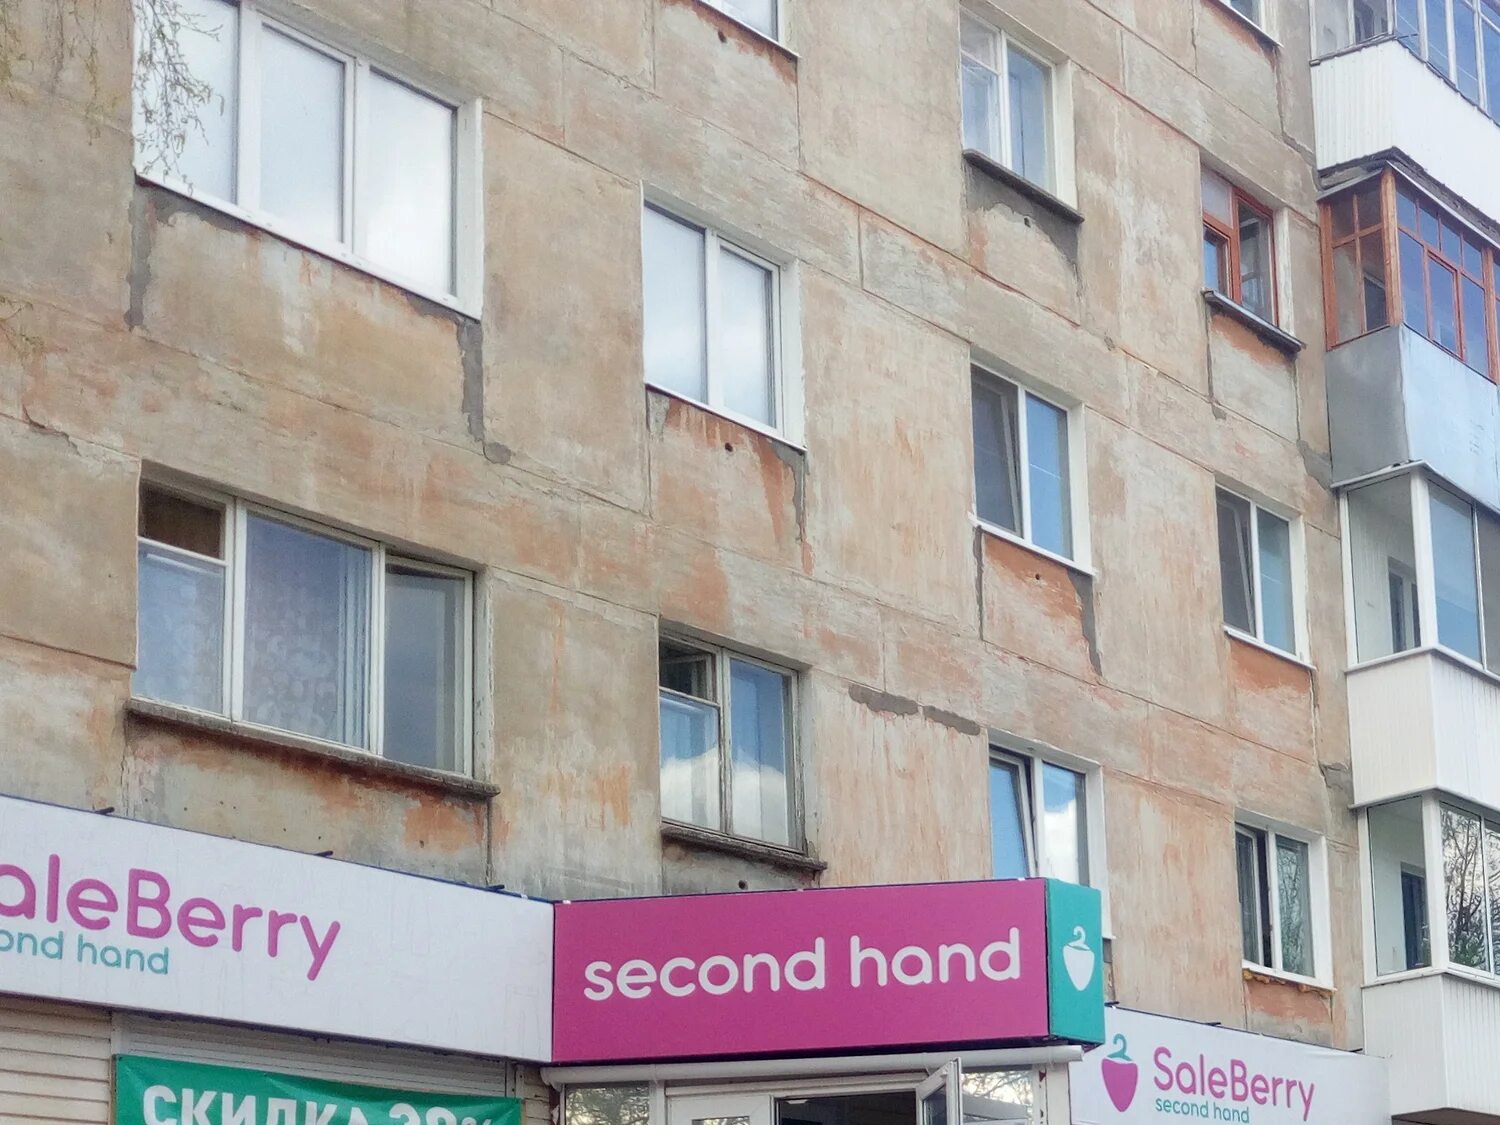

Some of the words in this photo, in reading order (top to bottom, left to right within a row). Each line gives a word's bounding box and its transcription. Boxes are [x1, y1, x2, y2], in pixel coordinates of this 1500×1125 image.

[0, 853, 341, 981] aleBerry
[77, 933, 169, 975] hand
[583, 936, 826, 1001] second
[850, 927, 1022, 988] hand
[1153, 1046, 1315, 1122] SaleBerry
[1155, 1097, 1209, 1119] second
[1213, 1102, 1250, 1124] hand
